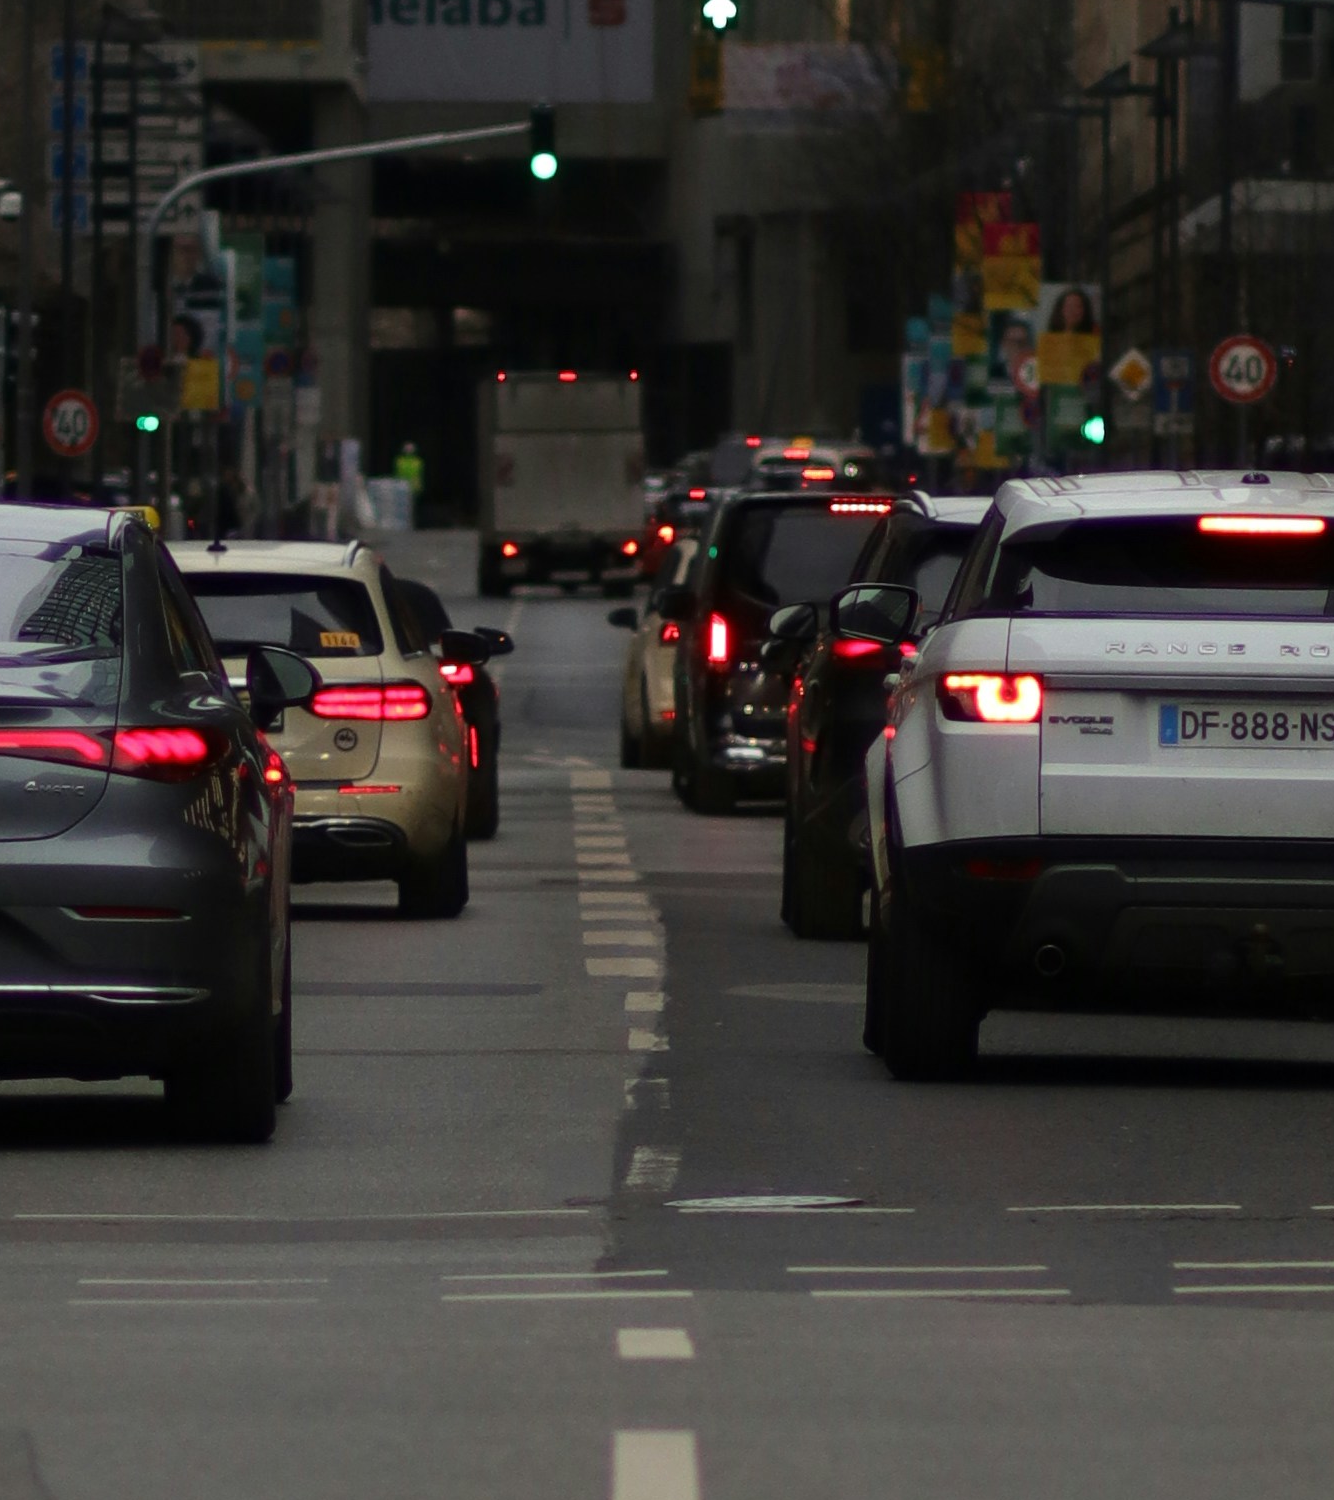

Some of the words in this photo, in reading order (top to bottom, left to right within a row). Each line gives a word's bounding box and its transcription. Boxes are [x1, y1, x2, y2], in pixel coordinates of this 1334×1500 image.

[1226, 354, 1263, 383] 40
[53, 408, 89, 437] 40
[1106, 642, 1246, 655] RANGE
[24, 780, 85, 797] 4MATIC
